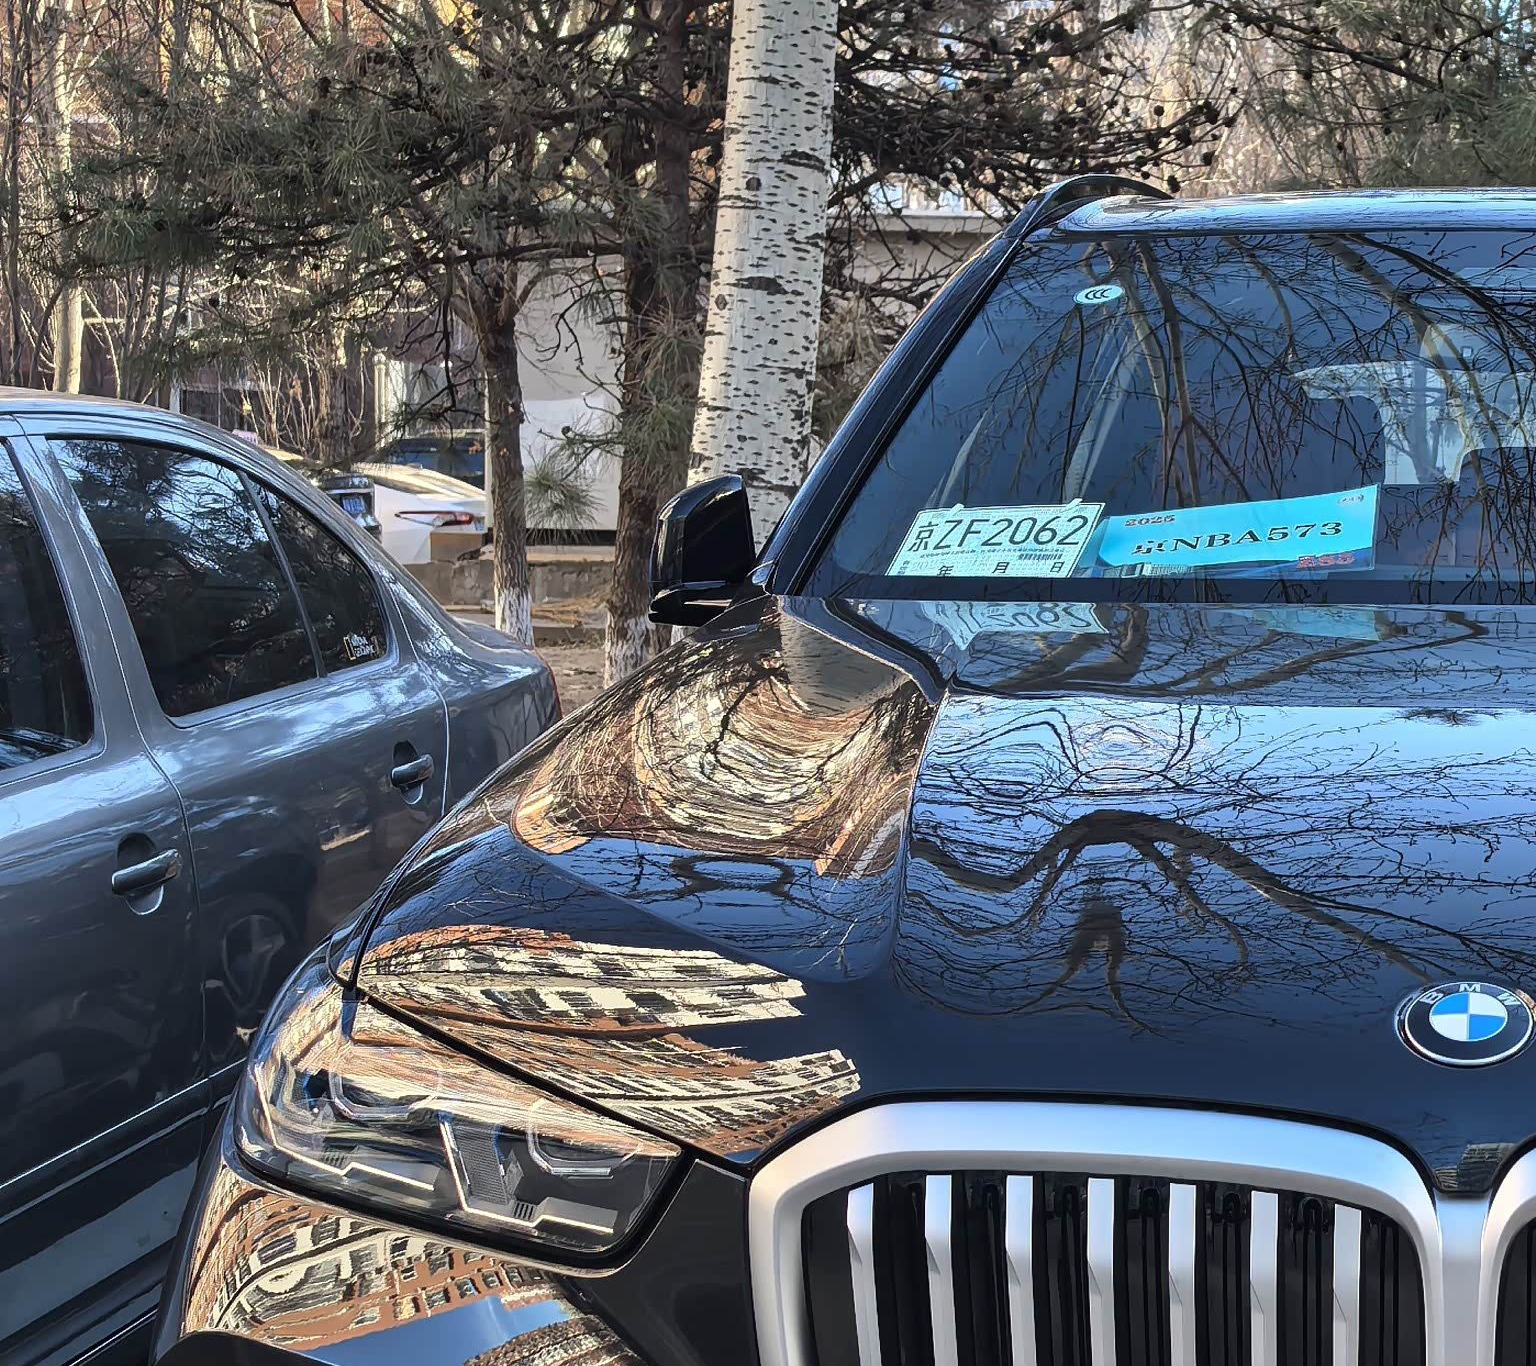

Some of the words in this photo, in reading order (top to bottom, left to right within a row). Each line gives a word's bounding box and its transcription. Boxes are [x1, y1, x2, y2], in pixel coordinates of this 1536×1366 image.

[1085, 288, 1112, 300] CCC
[908, 515, 1089, 552] 京ZF2062
[937, 565, 954, 576] 年
[992, 561, 1010, 574] 月
[1049, 561, 1065, 574] 日
[1419, 983, 1521, 1006] BMW
